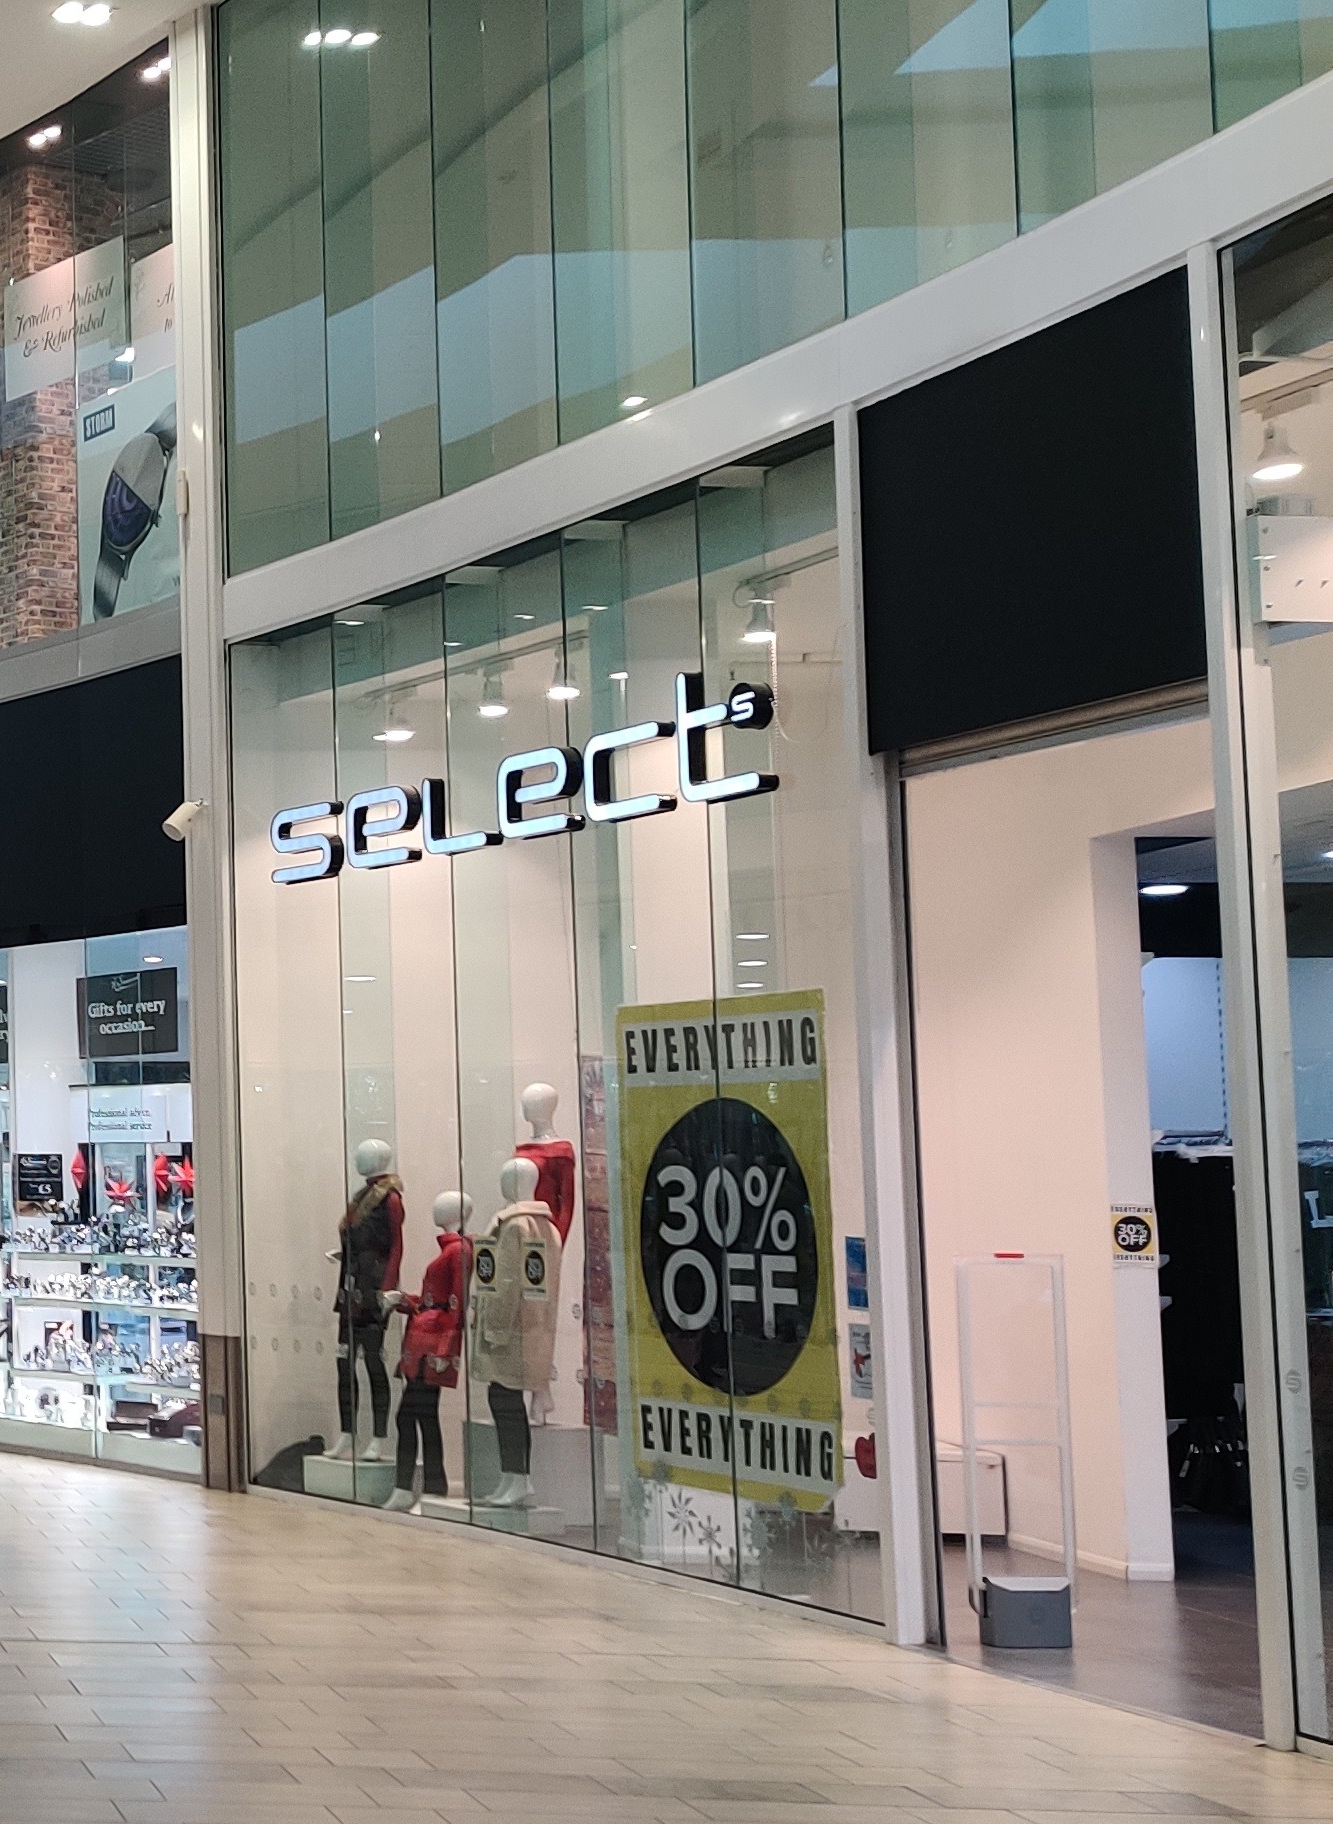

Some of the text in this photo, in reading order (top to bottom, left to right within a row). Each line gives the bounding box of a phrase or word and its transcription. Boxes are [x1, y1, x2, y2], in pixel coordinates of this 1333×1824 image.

[87, 999, 166, 1018] Gifts for every
[624, 1016, 818, 1075] EVERYTHING
[656, 1164, 798, 1252] 30%
[1117, 1223, 1149, 1237] 30%
[1117, 1234, 1148, 1246] OFF
[662, 1248, 800, 1340] OFF
[640, 1403, 834, 1482] EVERYTHING
